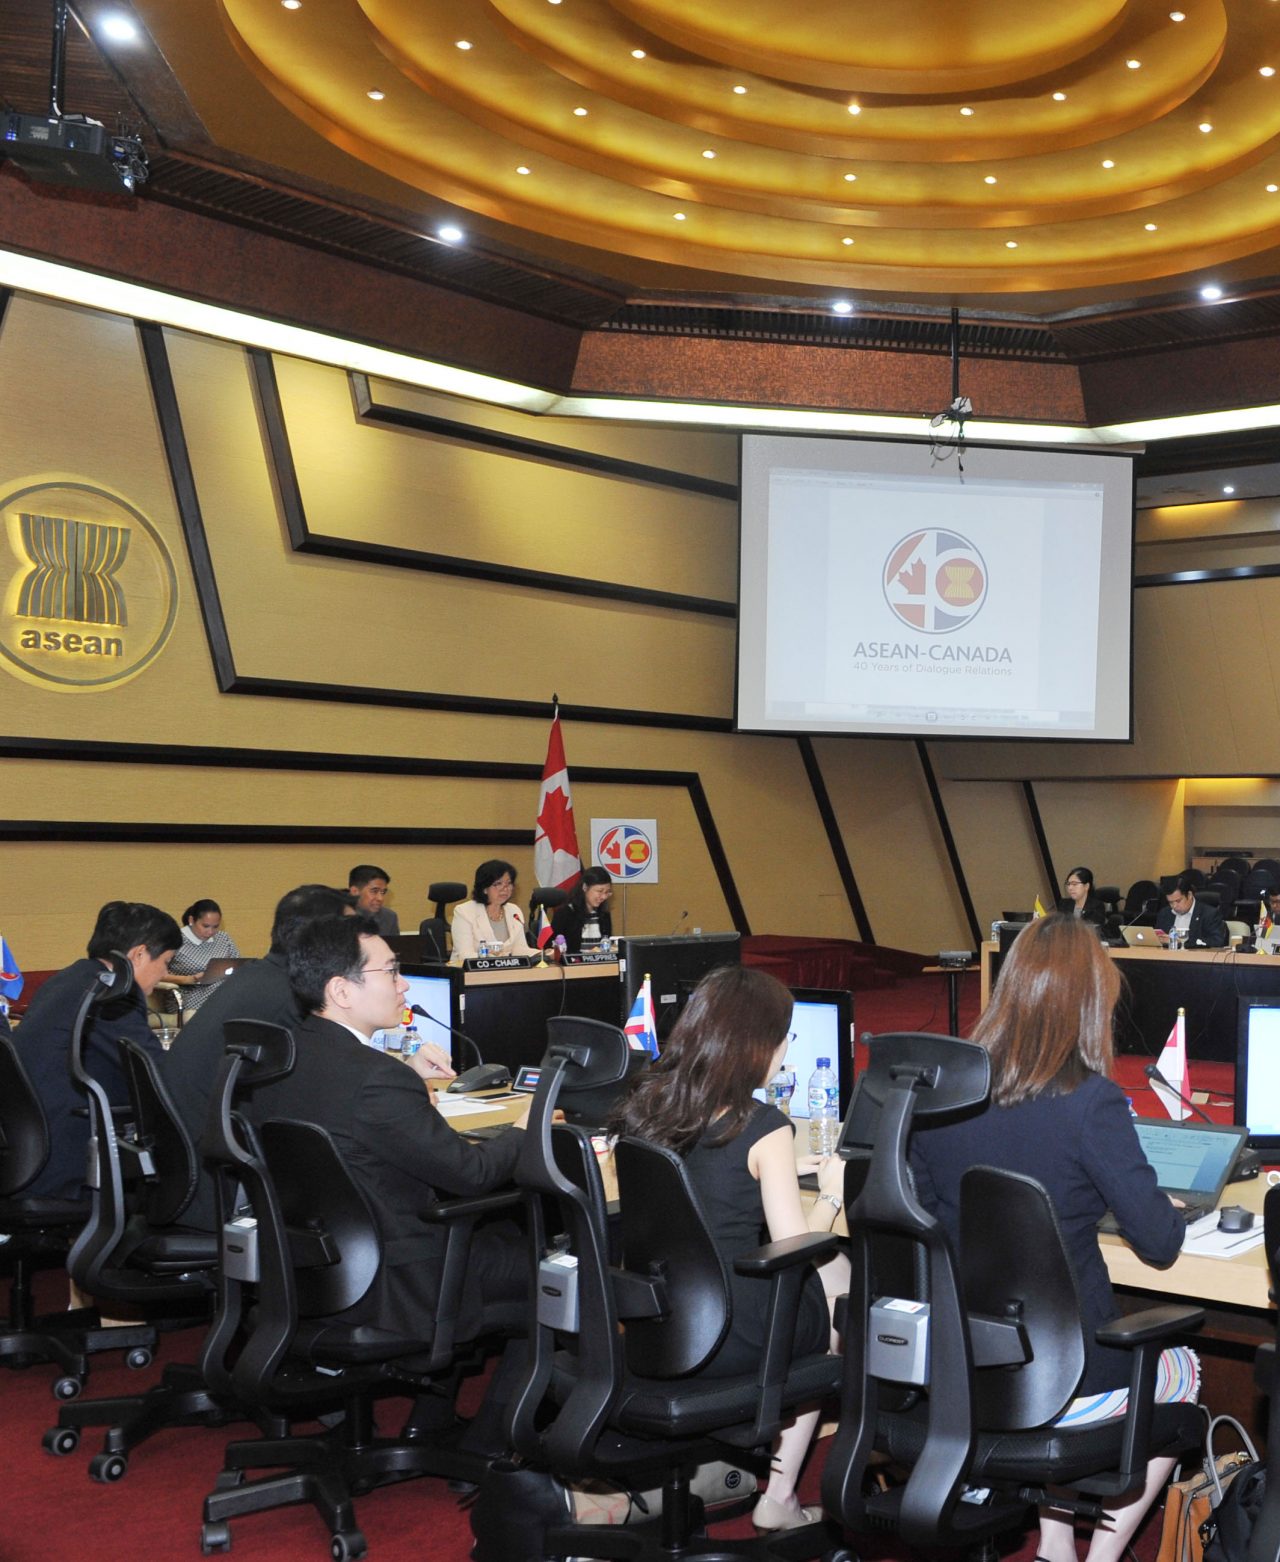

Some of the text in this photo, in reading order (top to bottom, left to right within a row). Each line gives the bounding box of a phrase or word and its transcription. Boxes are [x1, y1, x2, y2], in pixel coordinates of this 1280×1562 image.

[20, 628, 123, 657] asean
[853, 641, 1013, 664] ASEAN-CANADA
[853, 661, 1013, 677] 40 Years of Dialogue Relations
[582, 953, 618, 963] PHILIPPINES
